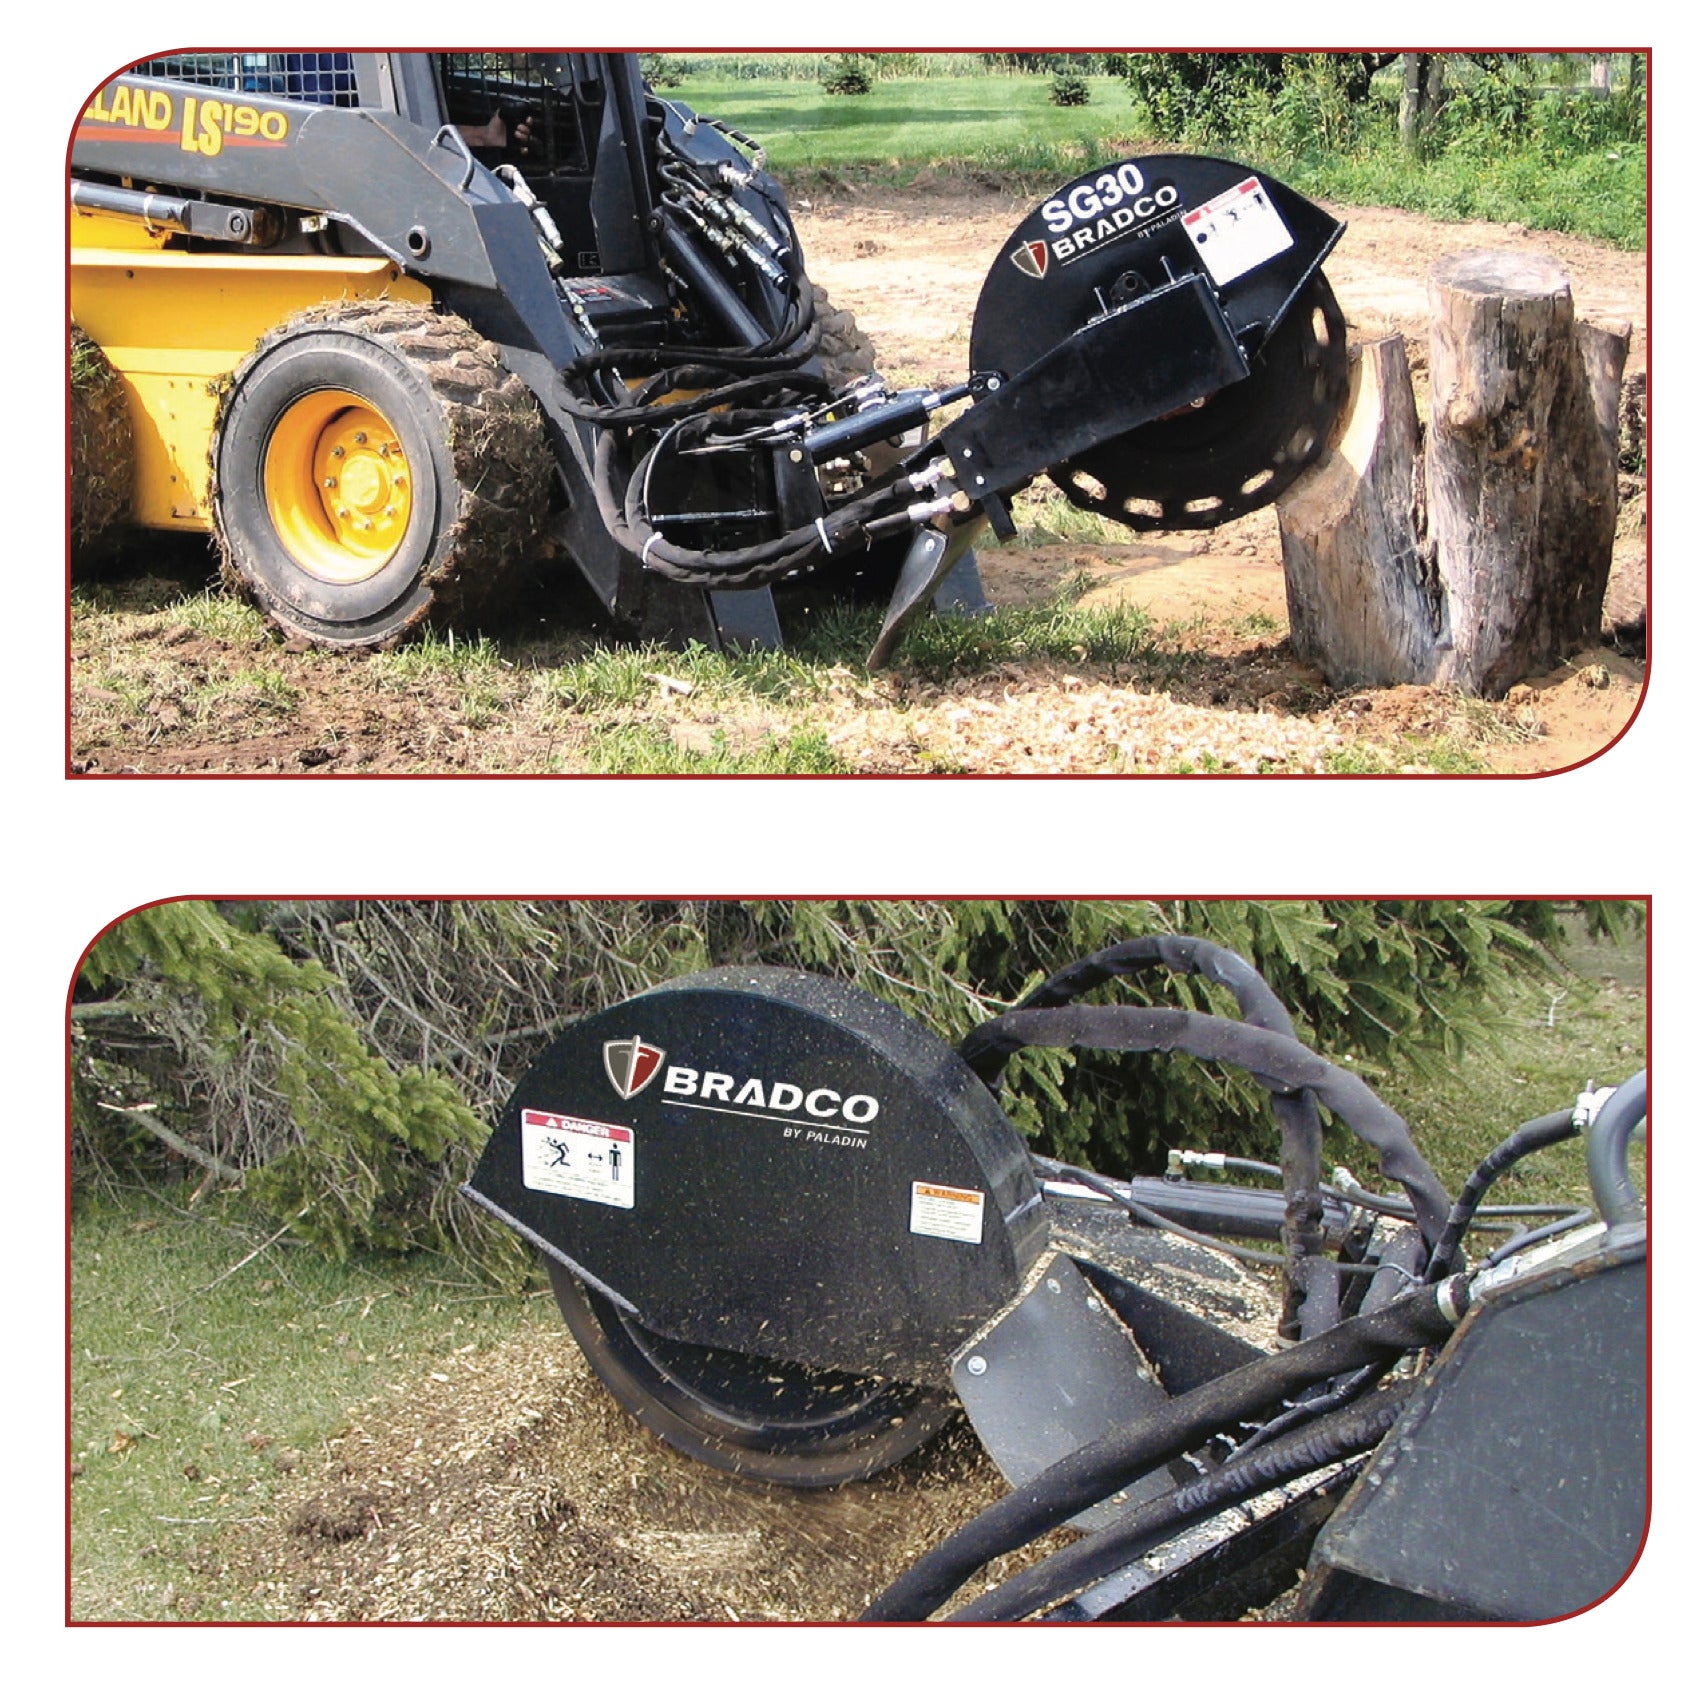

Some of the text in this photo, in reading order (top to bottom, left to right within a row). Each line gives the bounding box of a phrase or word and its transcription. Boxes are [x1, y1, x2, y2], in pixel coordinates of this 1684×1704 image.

[1041, 163, 1144, 233] SG30
[1051, 186, 1177, 260] BRADCO
[1137, 228, 1151, 239] BY
[663, 1066, 879, 1123] BRADCO
[783, 1126, 867, 1149] BY PALADIN
